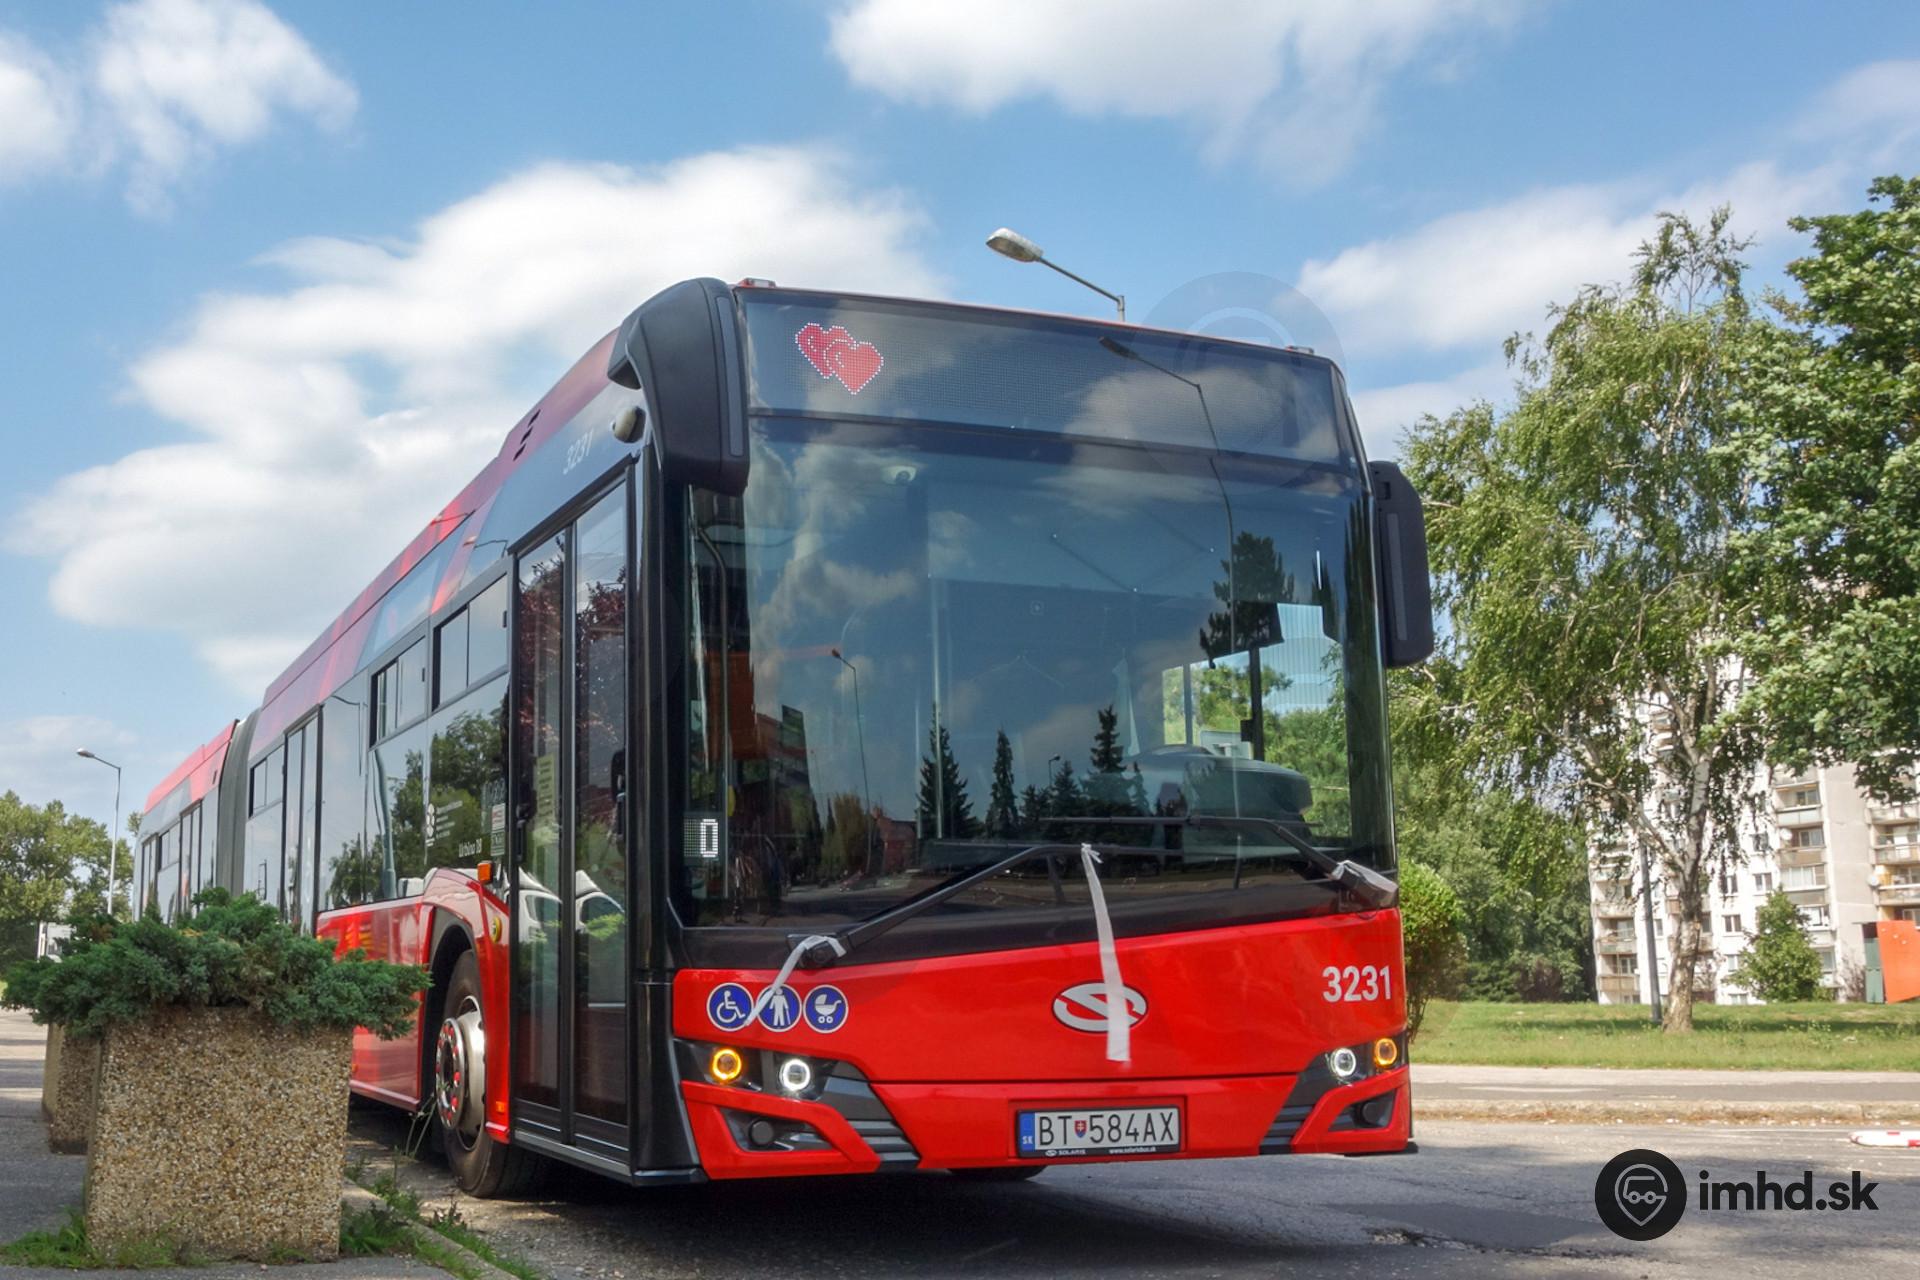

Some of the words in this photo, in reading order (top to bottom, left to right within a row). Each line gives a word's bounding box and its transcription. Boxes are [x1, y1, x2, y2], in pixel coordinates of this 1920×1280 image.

[563, 428, 594, 475] 3231
[1322, 964, 1392, 1003] 3231
[1022, 1135, 1034, 1146] SK
[1039, 1115, 1073, 1147] BT
[1089, 1111, 1175, 1144] 584AX
